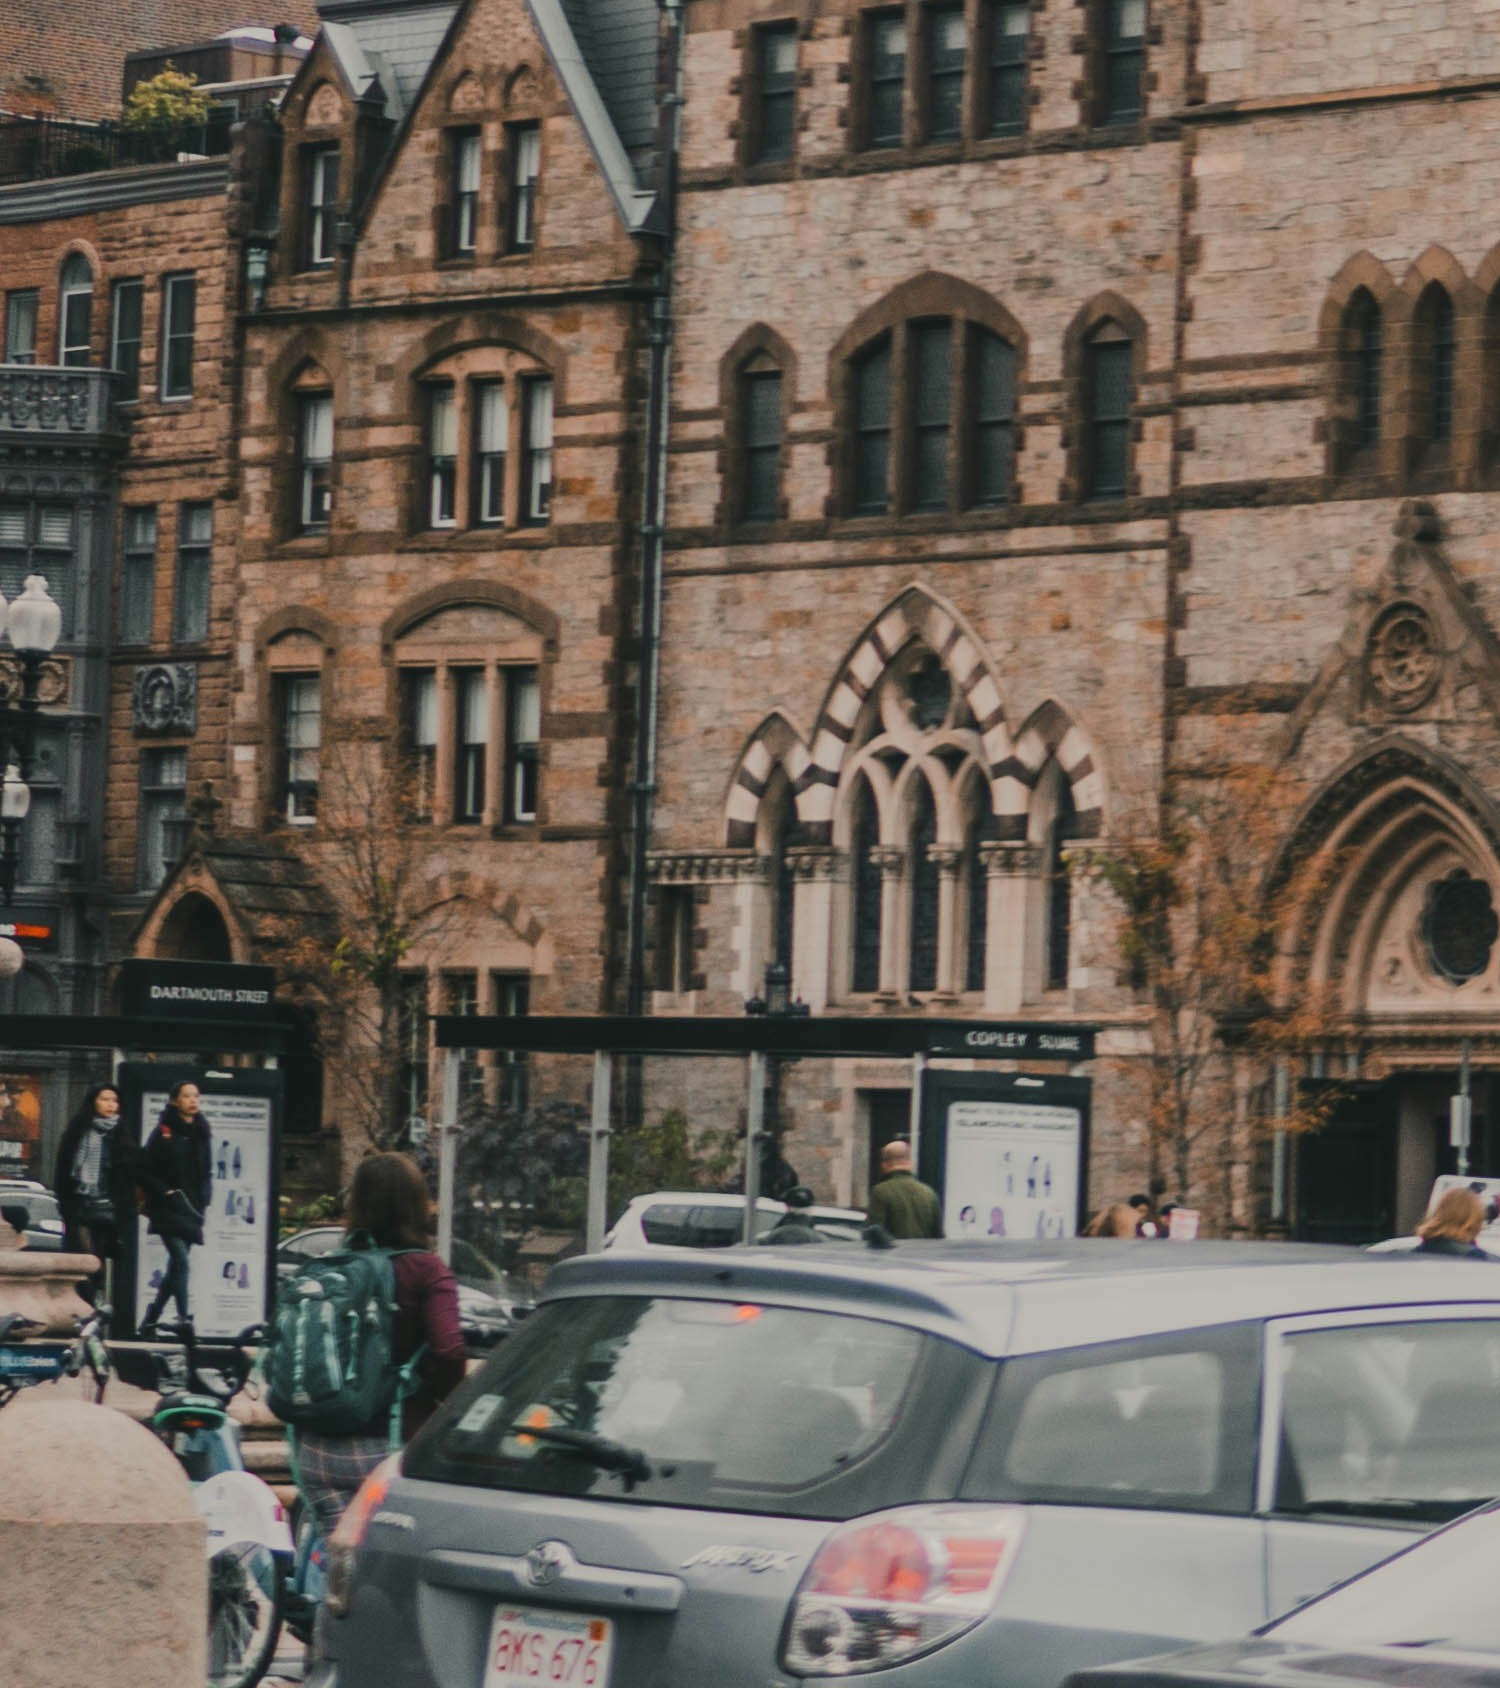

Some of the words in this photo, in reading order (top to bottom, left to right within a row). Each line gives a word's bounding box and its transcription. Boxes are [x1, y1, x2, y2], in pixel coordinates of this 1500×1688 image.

[150, 985, 232, 1003] DARTMOUTH
[235, 989, 269, 1004] STREET
[966, 1030, 1028, 1048] COPLEY
[1038, 1034, 1081, 1050] SQUARE
[550, 1638, 603, 1686] 676
